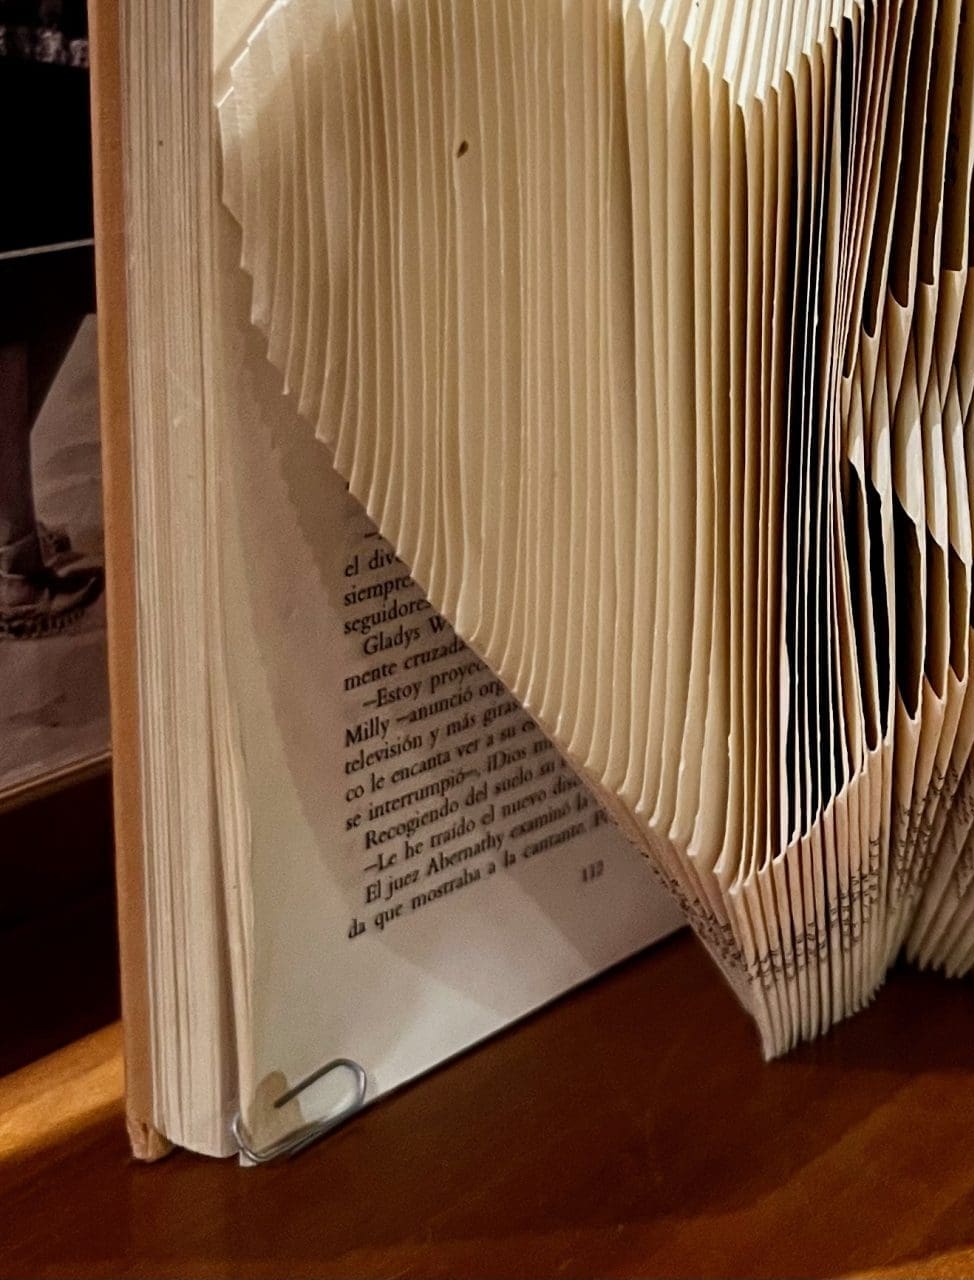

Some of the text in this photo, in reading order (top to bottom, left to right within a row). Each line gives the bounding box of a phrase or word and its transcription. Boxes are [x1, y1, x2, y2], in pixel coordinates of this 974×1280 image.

[344, 554, 360, 578] el
[362, 623, 421, 656] Gladys
[343, 662, 398, 691] mente
[344, 733, 423, 776] televisión
[430, 726, 440, 749] y
[446, 712, 477, 737] más
[345, 715, 390, 748] Milly
[345, 784, 365, 803] co
[370, 772, 386, 793] le
[390, 750, 452, 784] encanta
[455, 738, 479, 758] ver
[485, 733, 495, 749] a
[345, 813, 362, 832] se
[364, 796, 460, 850] Recogiendo
[464, 781, 489, 807] del
[493, 766, 534, 797] suelo
[403, 840, 425, 861] he
[480, 804, 496, 826] el
[501, 787, 548, 819] nuevo
[347, 919, 367, 940] da
[374, 903, 403, 931] que
[411, 868, 482, 911] mostraba
[487, 861, 497, 875] a
[503, 849, 517, 869] la
[364, 879, 382, 905] El
[384, 868, 420, 902] juez
[426, 831, 504, 877] Abernathy
